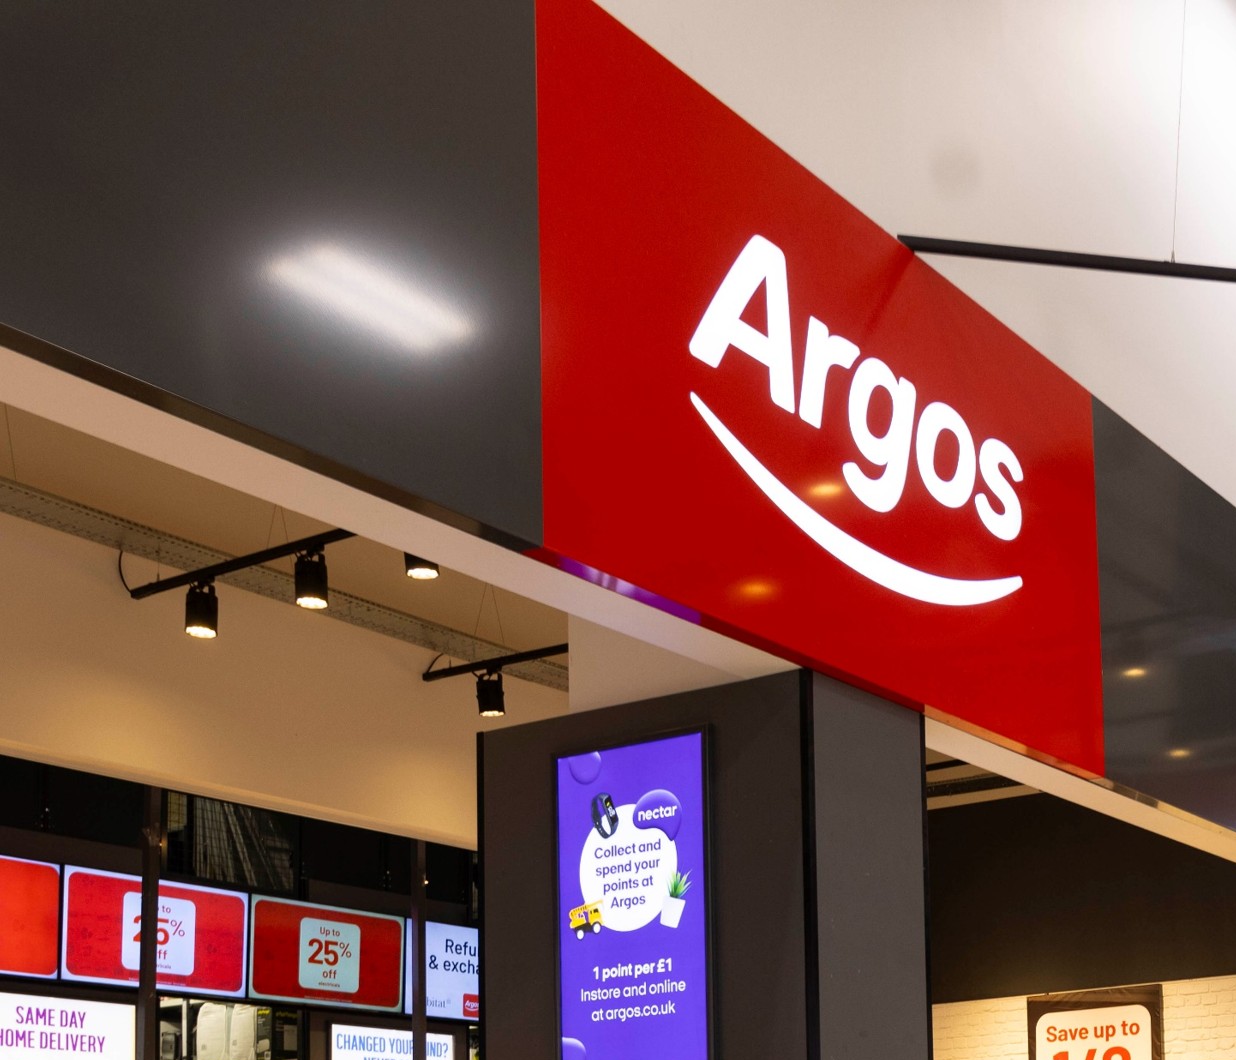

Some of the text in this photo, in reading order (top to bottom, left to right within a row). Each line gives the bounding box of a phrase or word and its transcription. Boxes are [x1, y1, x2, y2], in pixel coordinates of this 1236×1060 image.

[688, 233, 1024, 541] Argos
[638, 805, 678, 822] nectar
[594, 838, 660, 859] Collect and
[596, 858, 660, 878] spend your
[603, 875, 654, 895] points at
[610, 895, 646, 910] Argos
[320, 926, 340, 937] Up to
[308, 938, 352, 966] 25%
[445, 938, 476, 957] Refu
[428, 954, 438, 970] &
[592, 957, 672, 982] 1 point per £1
[322, 969, 337, 980] off
[580, 979, 686, 1002] Instore and online
[16, 1006, 86, 1029] SAME DAY
[591, 1000, 676, 1022] at argos.co.uk
[1046, 1020, 1140, 1042] Save up to
[40, 1032, 106, 1053] DELIVERY
[336, 1033, 386, 1053] CHANGED
[426, 1042, 449, 1058] IND?
